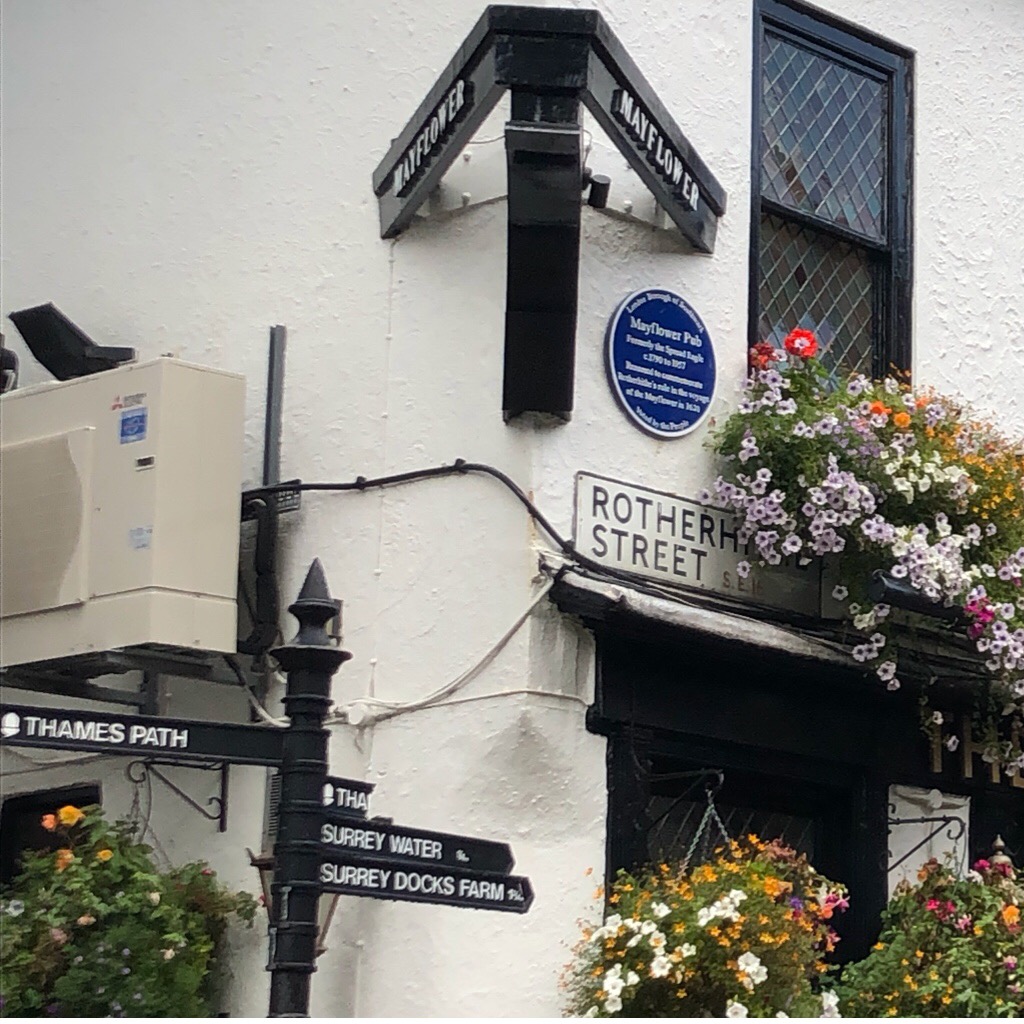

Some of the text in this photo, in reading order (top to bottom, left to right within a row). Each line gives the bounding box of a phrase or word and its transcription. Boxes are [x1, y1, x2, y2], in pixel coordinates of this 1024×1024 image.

[618, 89, 700, 211] MAYFLOWER
[630, 316, 702, 347] Mayflower Pub
[592, 485, 808, 570] ROTHERH
[592, 524, 707, 580] STREET
[23, 716, 188, 748] THAMES PATH
[321, 823, 386, 851] SURREY
[389, 834, 442, 860] WATER
[320, 863, 391, 889] SURREY
[393, 871, 455, 896] DOCKS
[459, 879, 505, 901] FARM
